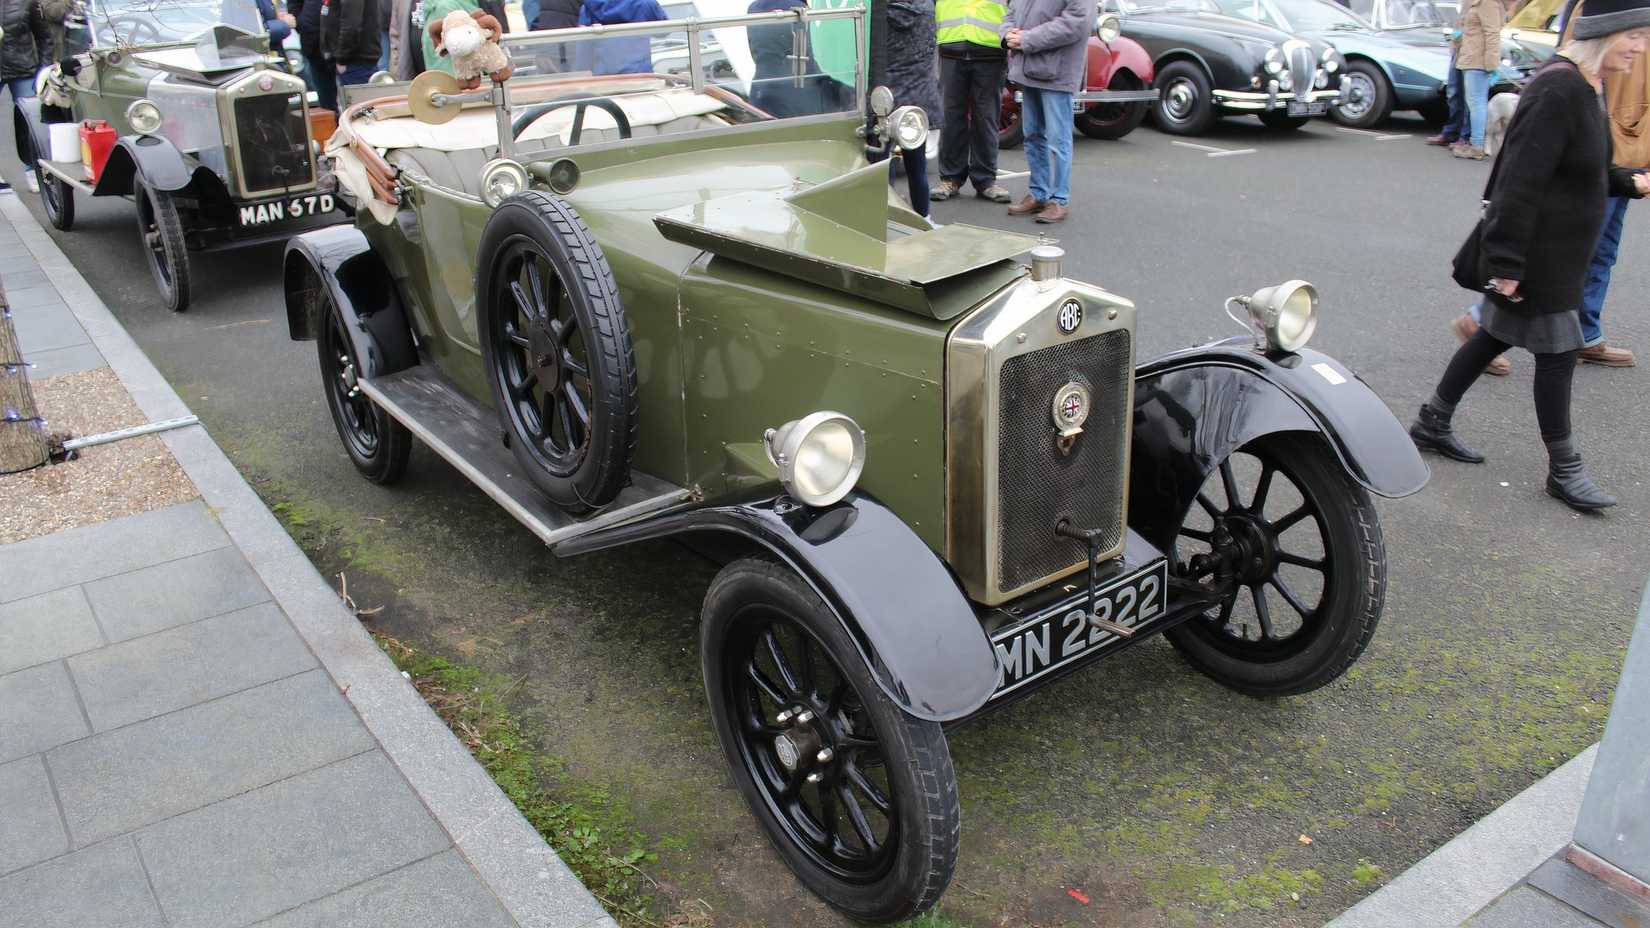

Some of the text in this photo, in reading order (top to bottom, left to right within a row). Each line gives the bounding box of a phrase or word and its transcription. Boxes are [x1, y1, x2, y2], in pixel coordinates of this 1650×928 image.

[240, 194, 335, 226] MAN 67D
[1060, 303, 1081, 330] ABC
[996, 574, 1160, 688] MN 2222
